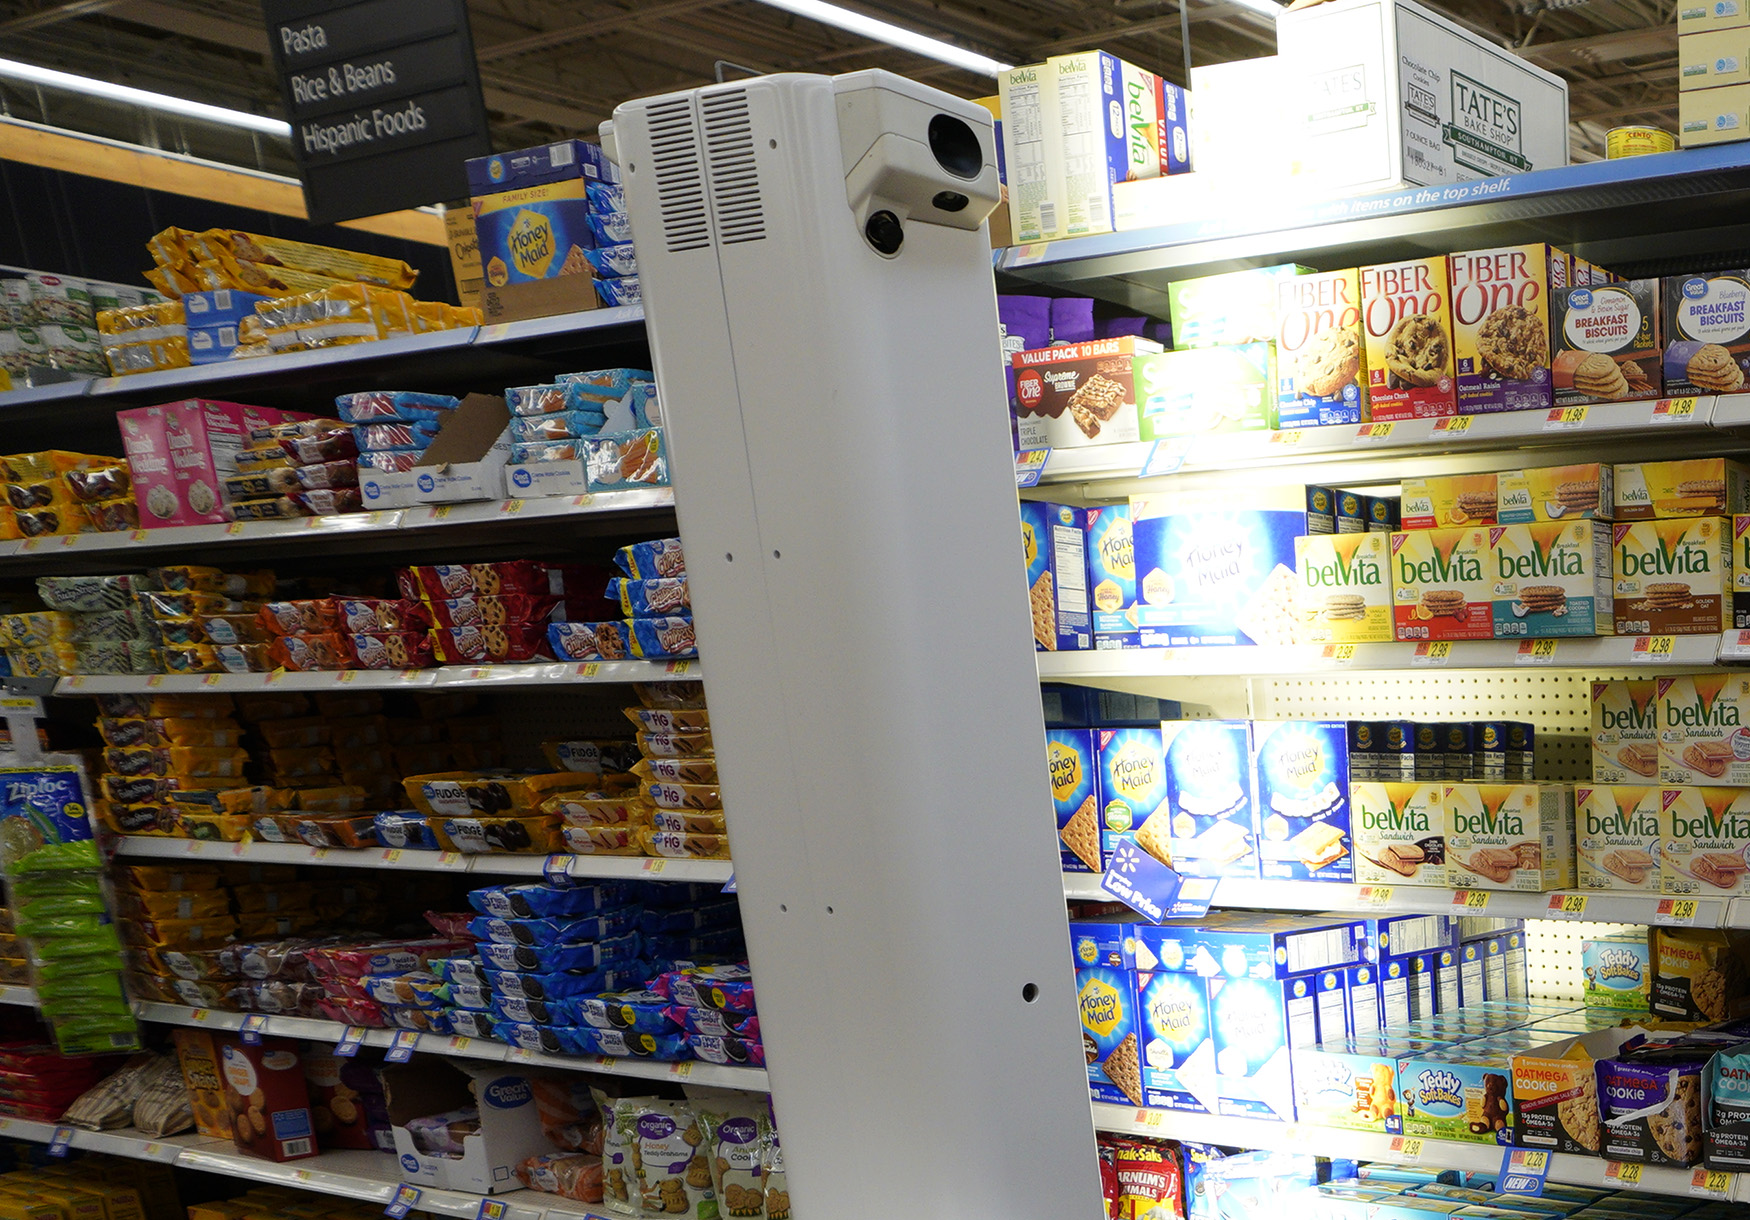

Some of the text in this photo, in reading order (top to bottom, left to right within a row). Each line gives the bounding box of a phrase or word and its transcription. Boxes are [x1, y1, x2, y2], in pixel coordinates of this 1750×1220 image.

[281, 26, 326, 55] Pasta
[291, 59, 394, 103] Rice & Beans
[1456, 82, 1518, 135] TATE'S
[302, 103, 425, 154] Hispanic Foods
[1126, 80, 1145, 165] belVita
[1464, 116, 1510, 145] BAKE SHOP
[1416, 191, 1439, 202] the
[1443, 187, 1468, 200] top
[1472, 179, 1509, 194] shelf.
[511, 226, 548, 252] Honey
[522, 239, 549, 262] Maid
[1362, 266, 1435, 300] FIBER
[1575, 314, 1628, 328] BREAKFAST
[1690, 301, 1745, 317] BREAKFAST
[1701, 312, 1744, 325] BISCUITS
[1585, 325, 1628, 338] BISCUITS
[1022, 341, 1119, 364] VALUE PACK 10 BARS
[1420, 1071, 1460, 1091] Teddy
